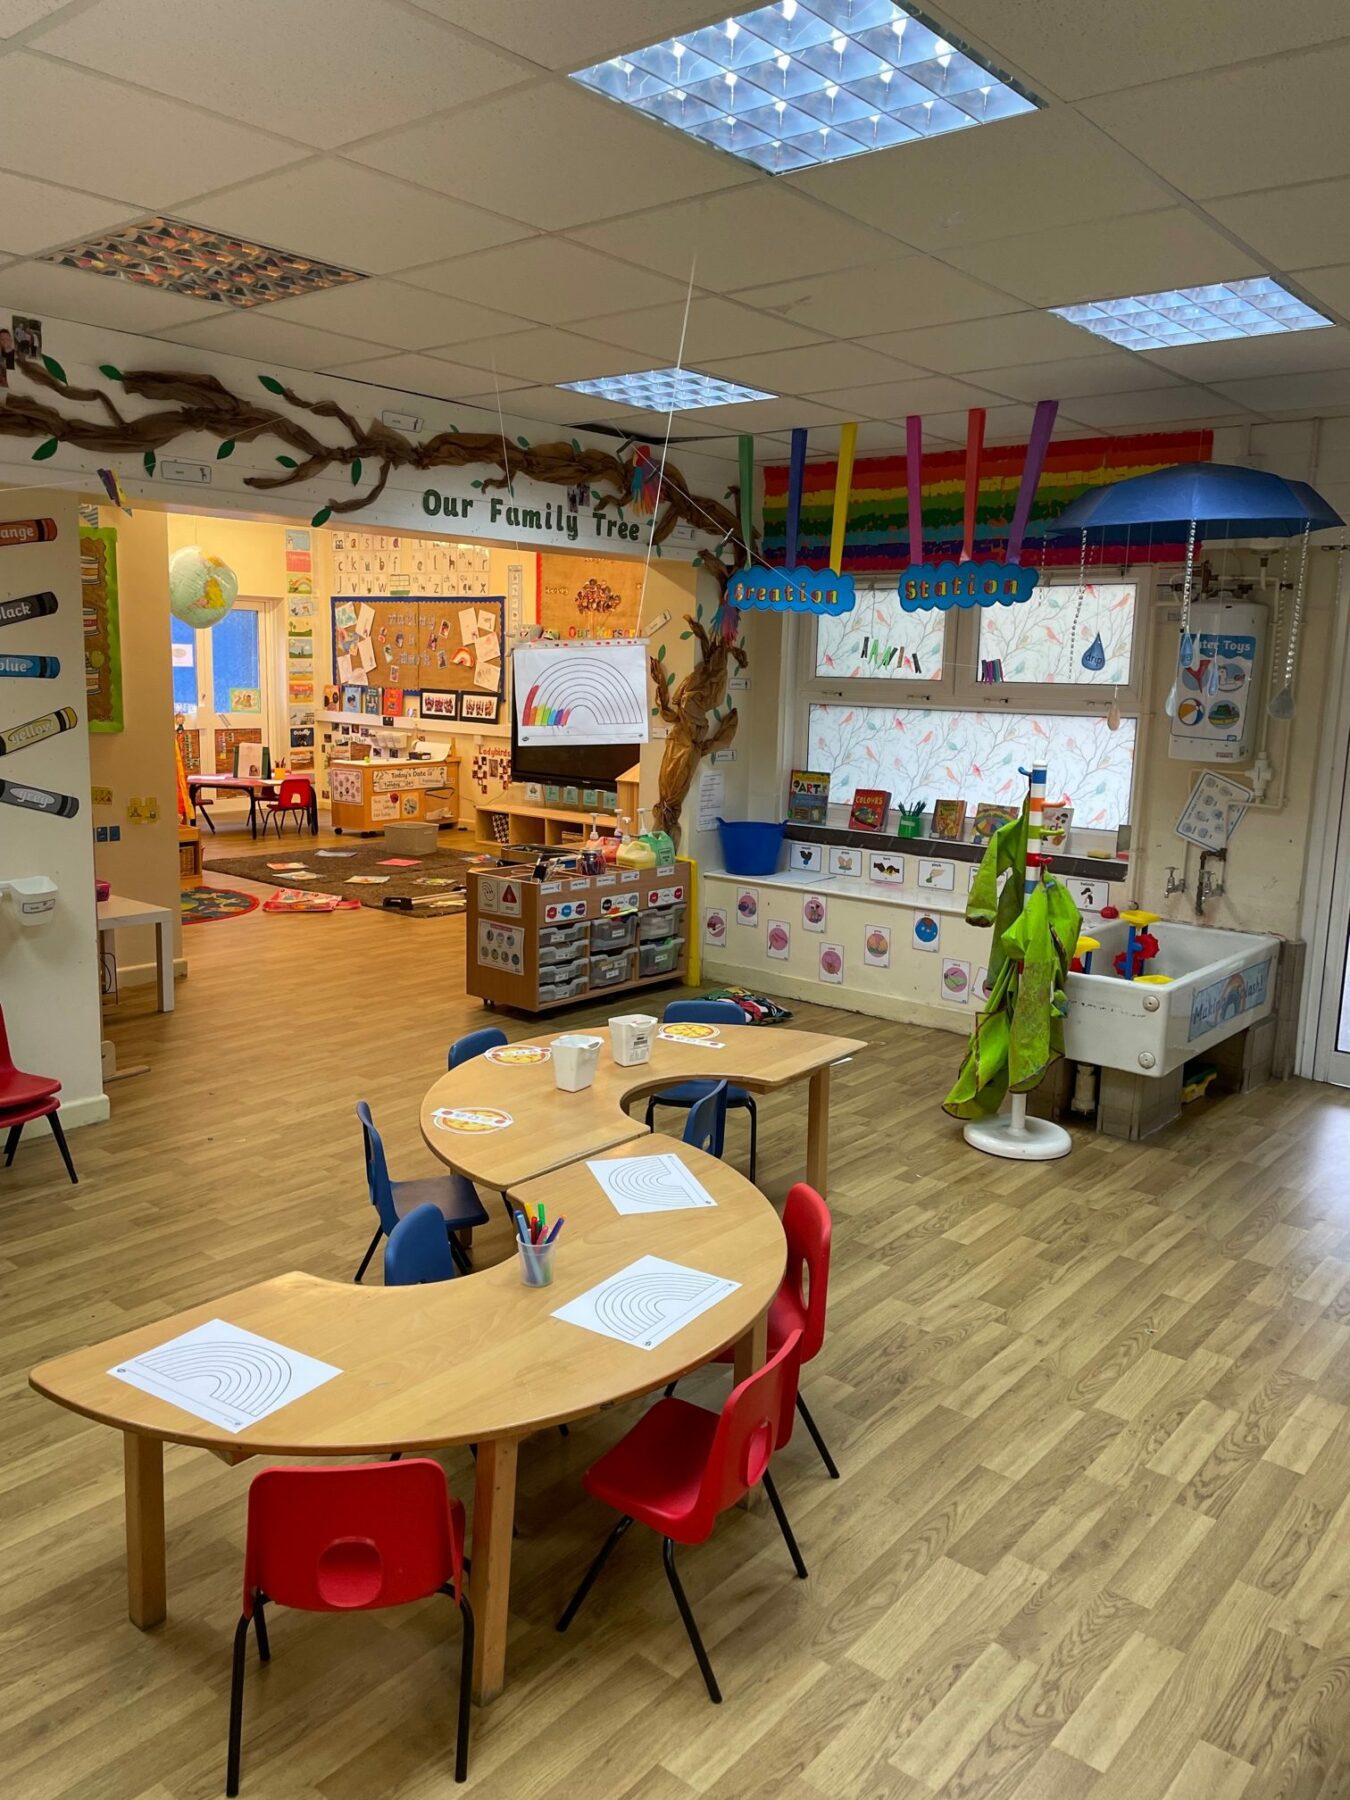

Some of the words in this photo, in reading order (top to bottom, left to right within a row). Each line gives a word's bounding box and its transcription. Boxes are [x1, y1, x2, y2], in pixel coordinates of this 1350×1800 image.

[422, 489, 474, 518] Our
[490, 498, 579, 540] Family
[592, 512, 640, 541] Tree
[0, 527, 34, 540] ange
[733, 582, 838, 604] Creation
[905, 573, 1018, 600] Station
[0, 602, 31, 620] lack
[1199, 640, 1219, 650] ter
[1223, 640, 1251, 654] Toys
[1086, 652, 1104, 667] drip
[11, 722, 55, 745] yellow
[17, 789, 51, 808] grey
[855, 795, 883, 805] COLOURS
